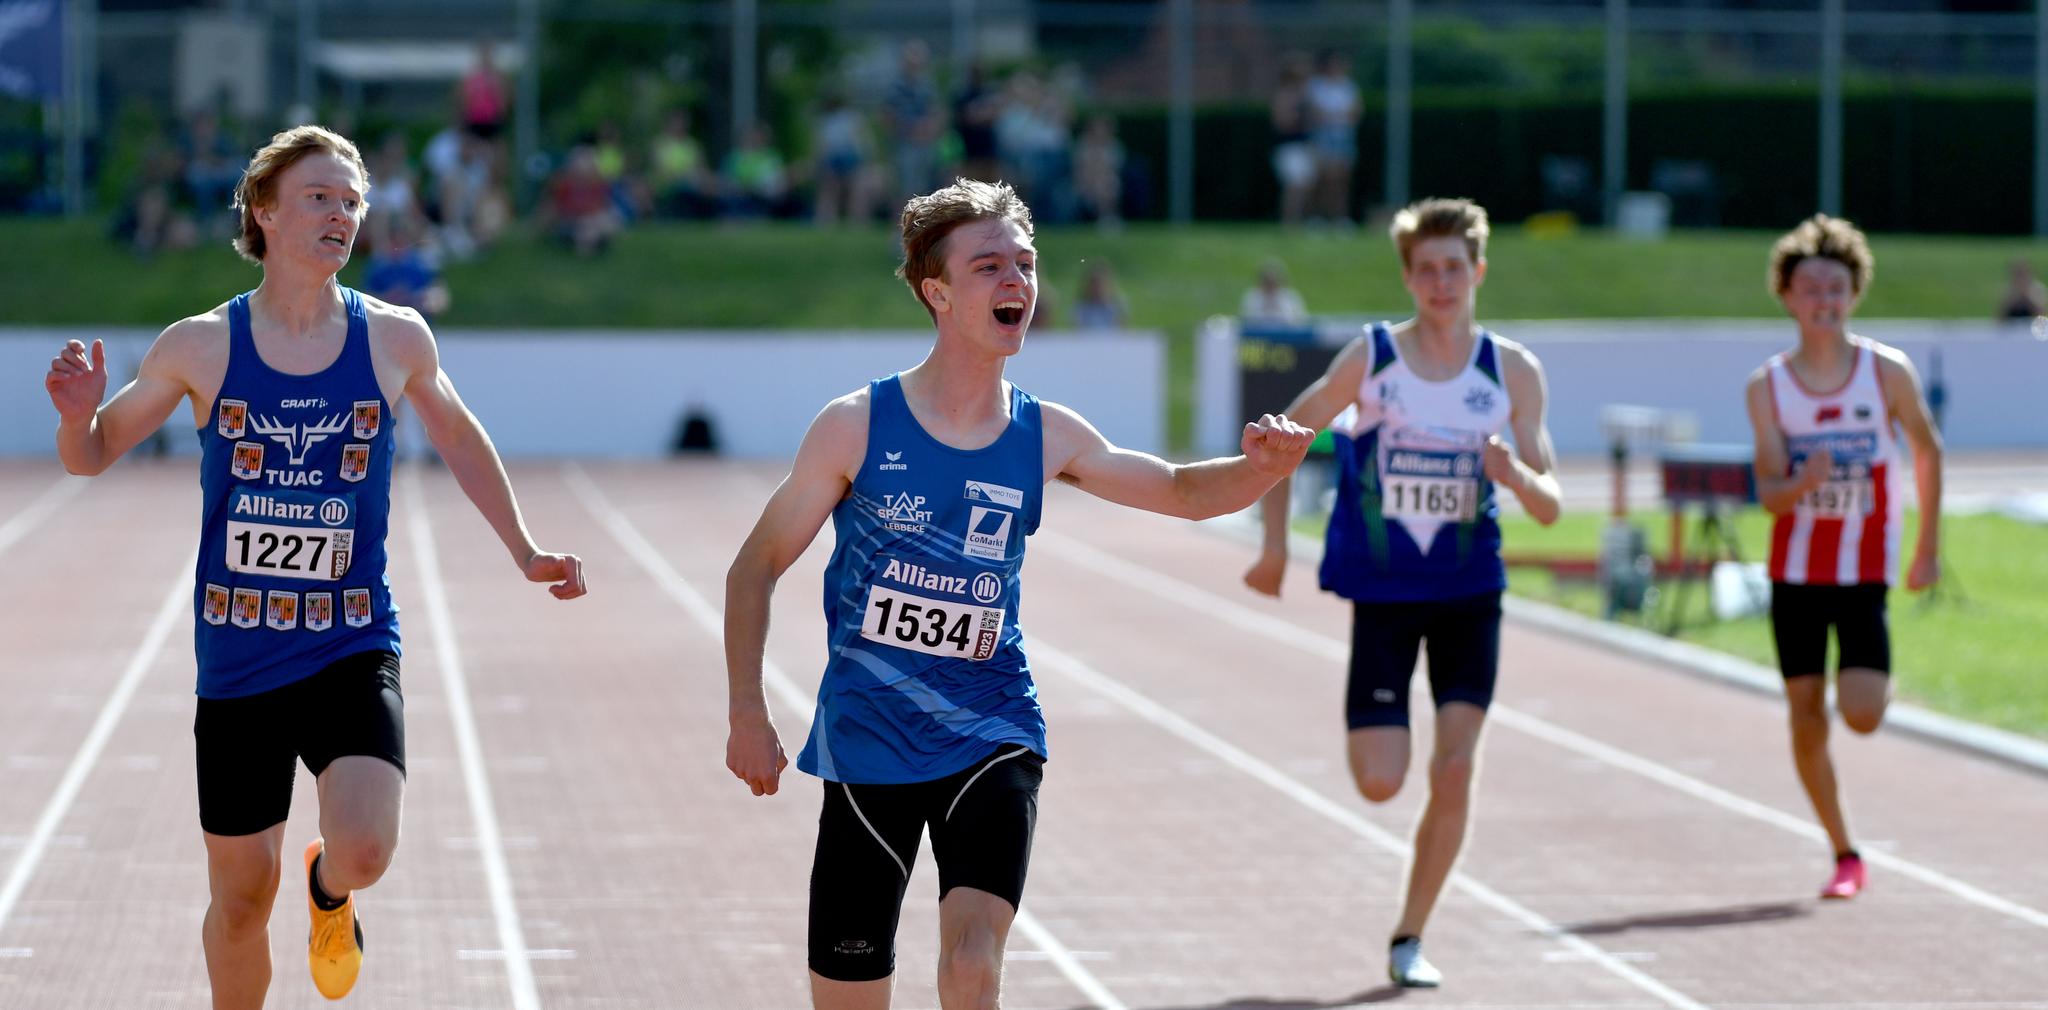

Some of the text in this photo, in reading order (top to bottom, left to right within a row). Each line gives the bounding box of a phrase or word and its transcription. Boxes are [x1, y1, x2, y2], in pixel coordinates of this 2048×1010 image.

[281, 399, 319, 408] CRAFT
[879, 463, 908, 471] erima
[1391, 451, 1450, 473] Allianz
[265, 469, 323, 486] TUAC
[235, 493, 315, 520] Allianz
[1392, 481, 1458, 515] 1165
[884, 522, 926, 533] LEBBEKE
[234, 530, 328, 572] 1227
[969, 534, 1003, 547] CoMarkt
[334, 552, 346, 577] 2023
[882, 558, 968, 595] Allianz
[874, 598, 972, 652] 1534
[978, 632, 993, 657] 2023
